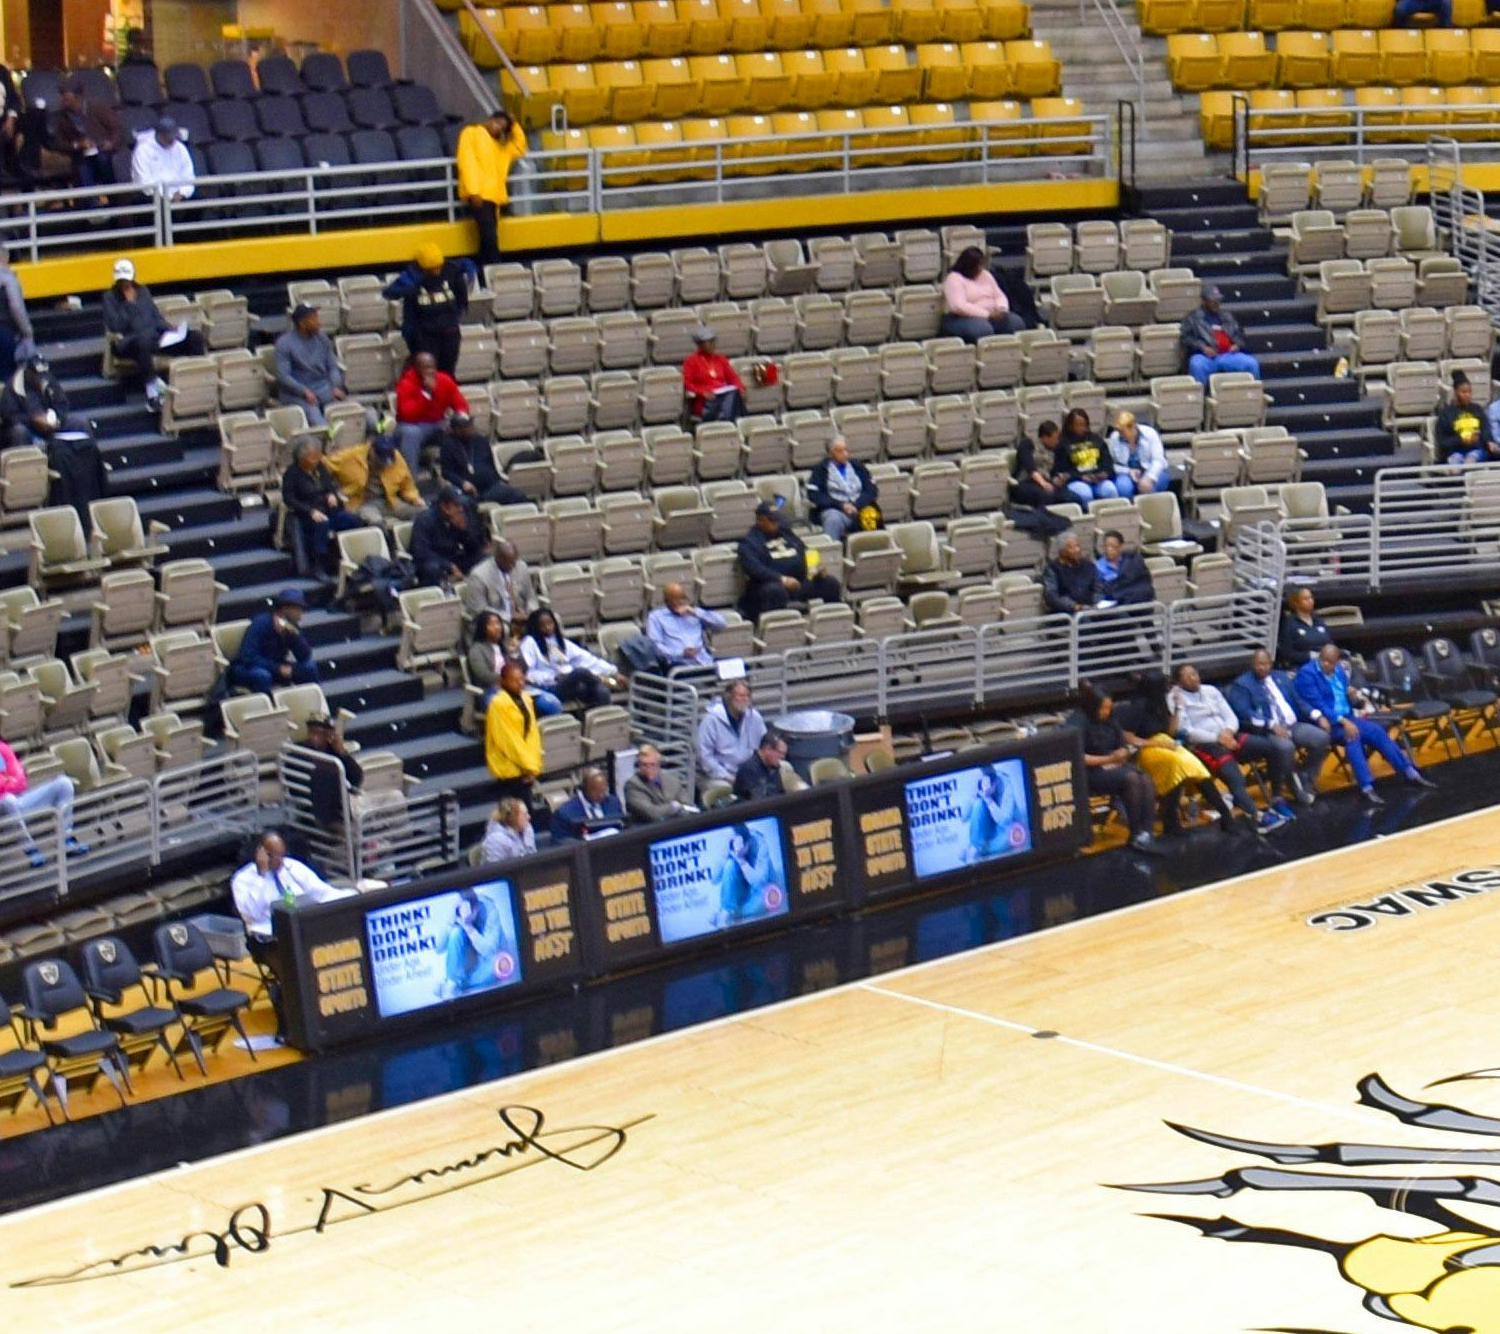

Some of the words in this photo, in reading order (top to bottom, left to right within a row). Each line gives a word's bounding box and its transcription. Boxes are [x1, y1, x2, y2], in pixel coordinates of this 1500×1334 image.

[906, 778, 959, 803] THINK!
[1053, 781, 1075, 805] THE
[908, 795, 952, 815] DON'T
[910, 806, 963, 829] DRINK!
[651, 838, 708, 865] THINK!
[811, 840, 835, 864] THE
[865, 827, 903, 857] STATE
[653, 856, 701, 878] DON'T
[655, 868, 713, 893] DRINK!
[544, 905, 572, 931] THE
[604, 890, 647, 921] STATE
[369, 905, 432, 932] THINK!
[371, 925, 424, 948] DON'T
[373, 938, 438, 963] DRINK!
[316, 960, 363, 995] STATE
